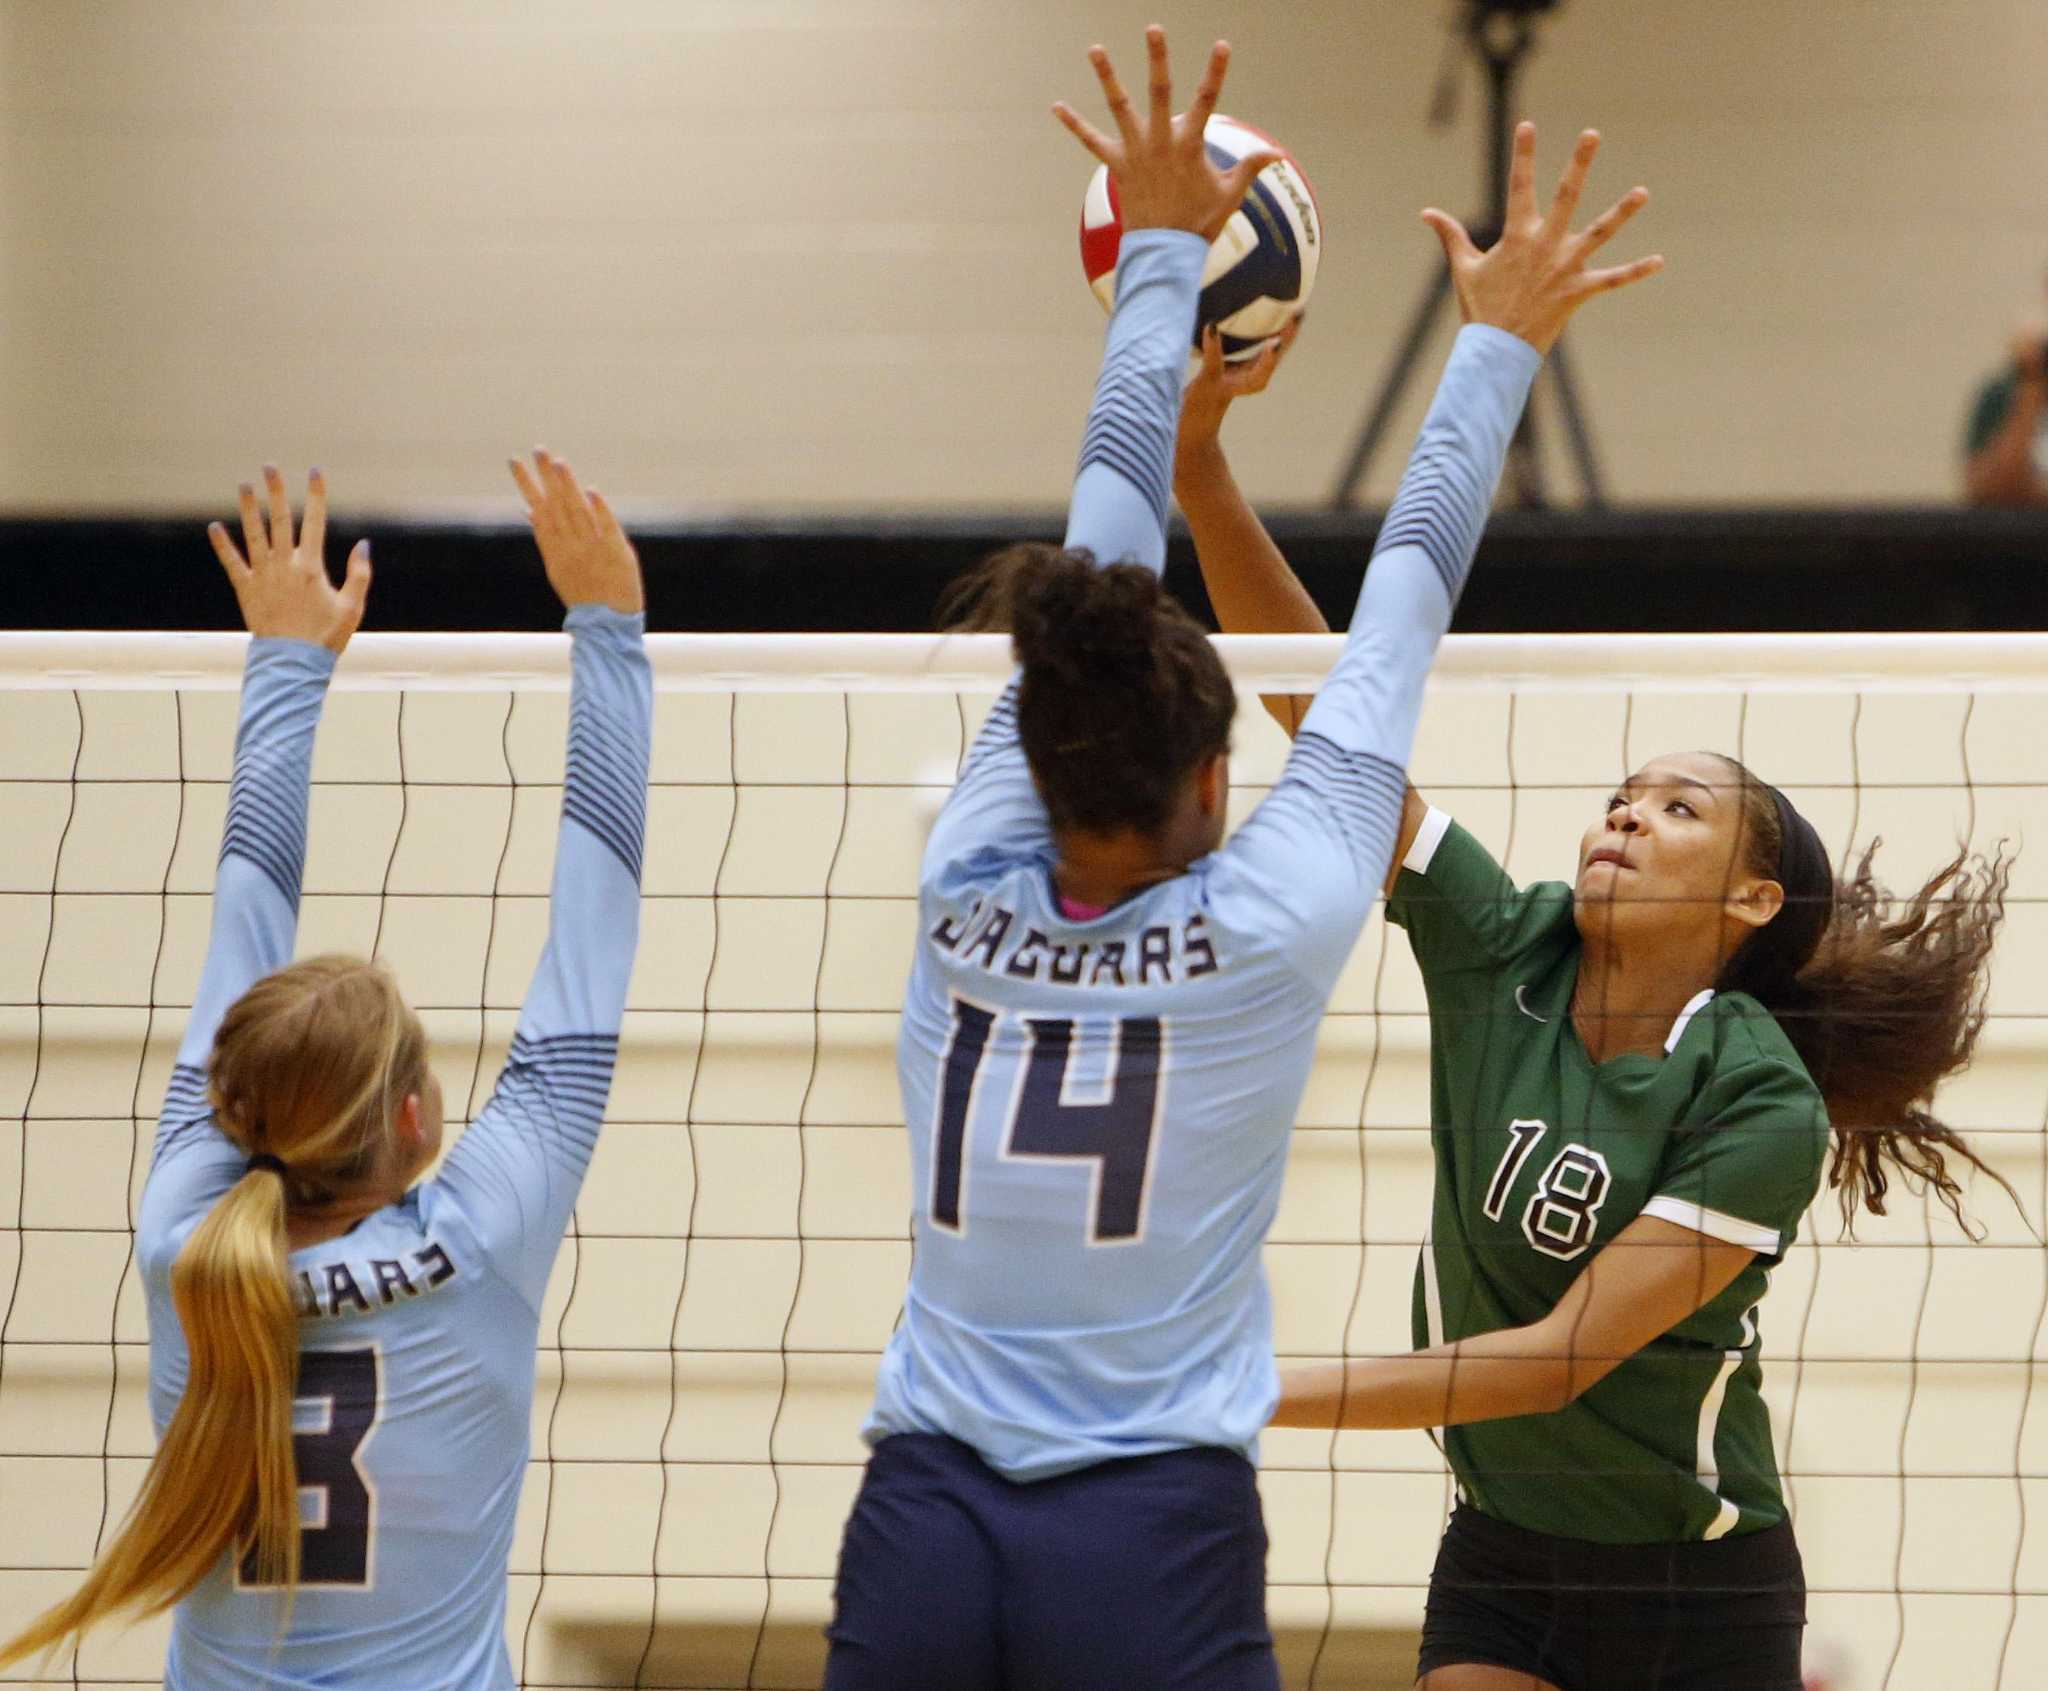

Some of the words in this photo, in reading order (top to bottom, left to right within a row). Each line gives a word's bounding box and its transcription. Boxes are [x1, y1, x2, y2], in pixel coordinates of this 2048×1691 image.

[930, 899, 1219, 987] JAGUARS
[929, 989, 1167, 1247] 14
[1483, 1118, 1612, 1262] 18
